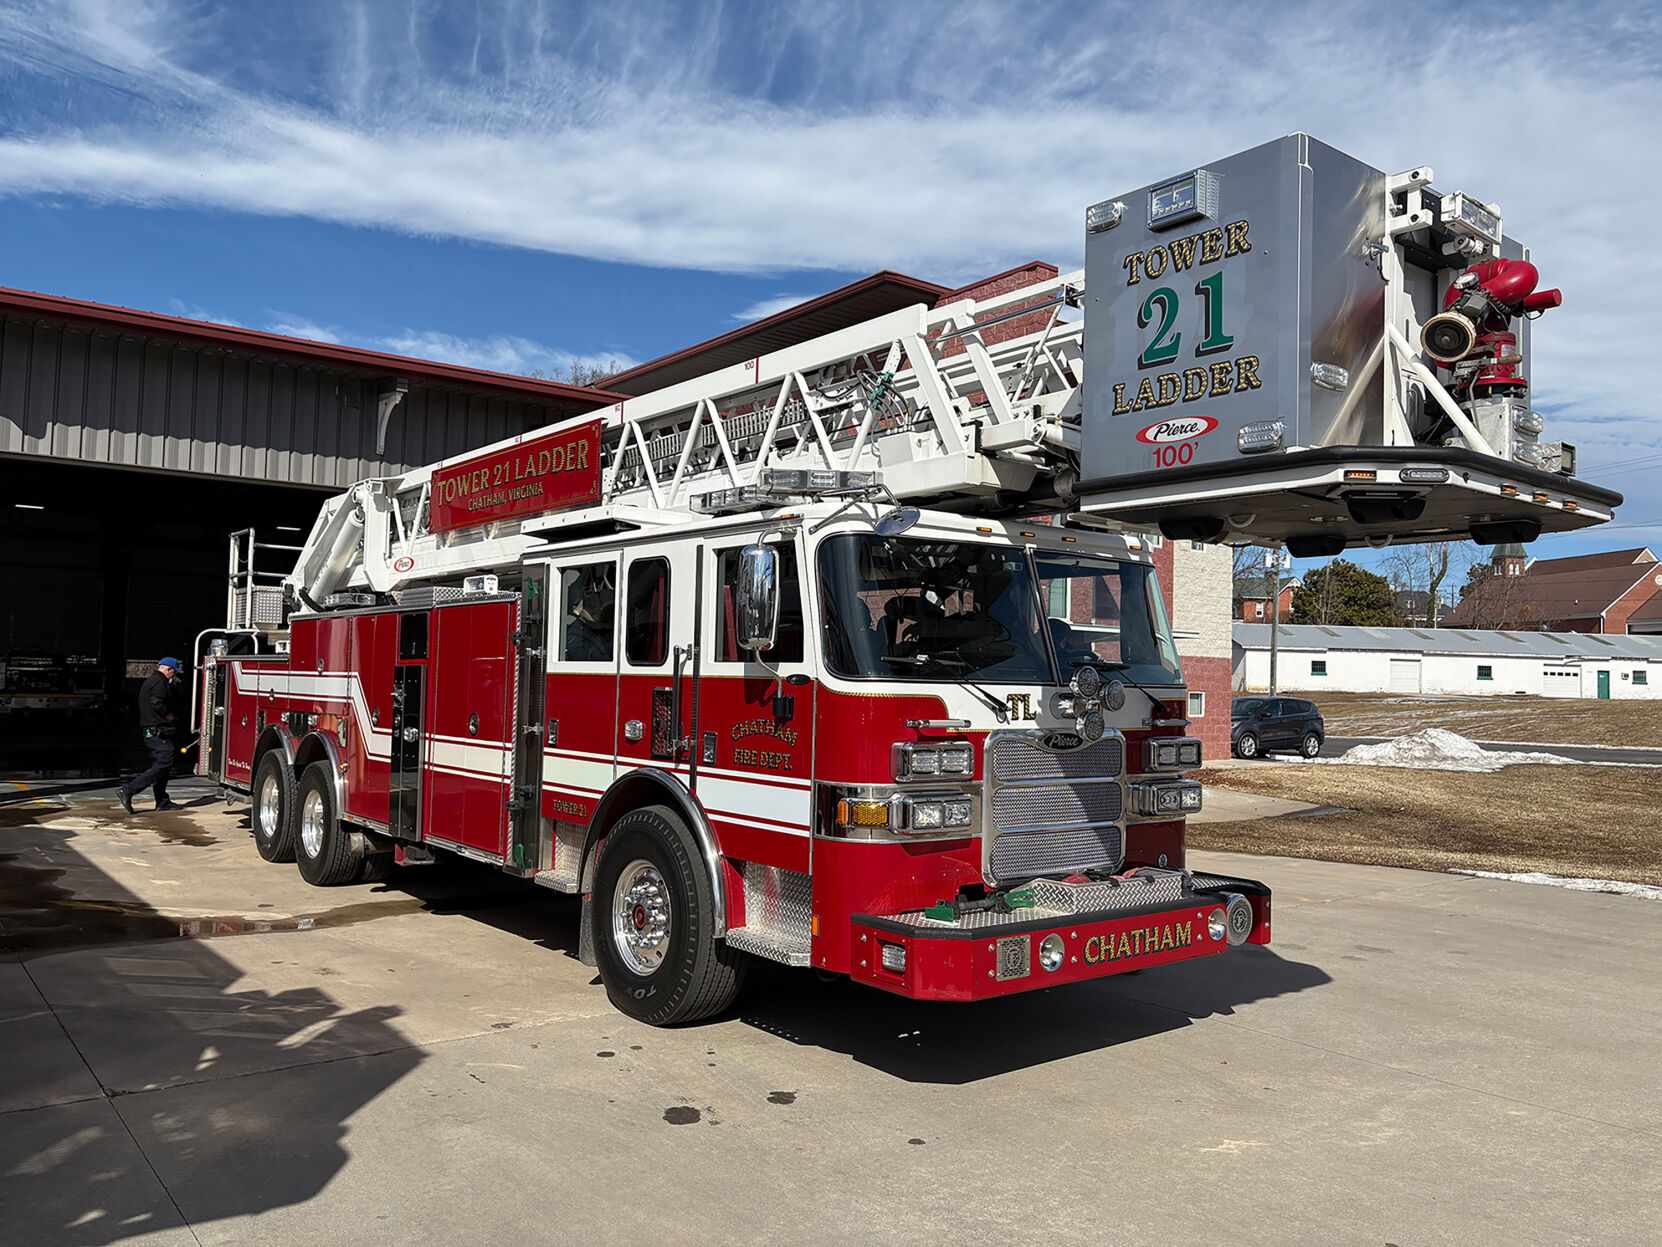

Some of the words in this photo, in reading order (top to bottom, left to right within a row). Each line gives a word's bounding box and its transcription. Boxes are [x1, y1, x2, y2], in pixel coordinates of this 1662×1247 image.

[1123, 220, 1252, 286] TOWER
[1137, 271, 1234, 370] 21
[744, 361, 754, 370] 100
[1112, 355, 1262, 416] LADDER
[1153, 422, 1200, 441] Pierce
[437, 468, 489, 507] TOWER
[493, 461, 510, 487] 21
[515, 439, 589, 481] LADDER
[468, 491, 506, 512] CHATHAM,
[508, 481, 544, 501] VIRGINIA
[1006, 694, 1037, 720] TL
[731, 718, 798, 748] CHATHAM
[1049, 734, 1079, 748] Pierce
[734, 748, 757, 767] FIRE
[759, 750, 793, 771] DEPT.
[552, 799, 578, 816] TOWER
[579, 804, 587, 818] 21
[1084, 921, 1192, 966] CHATHAM
